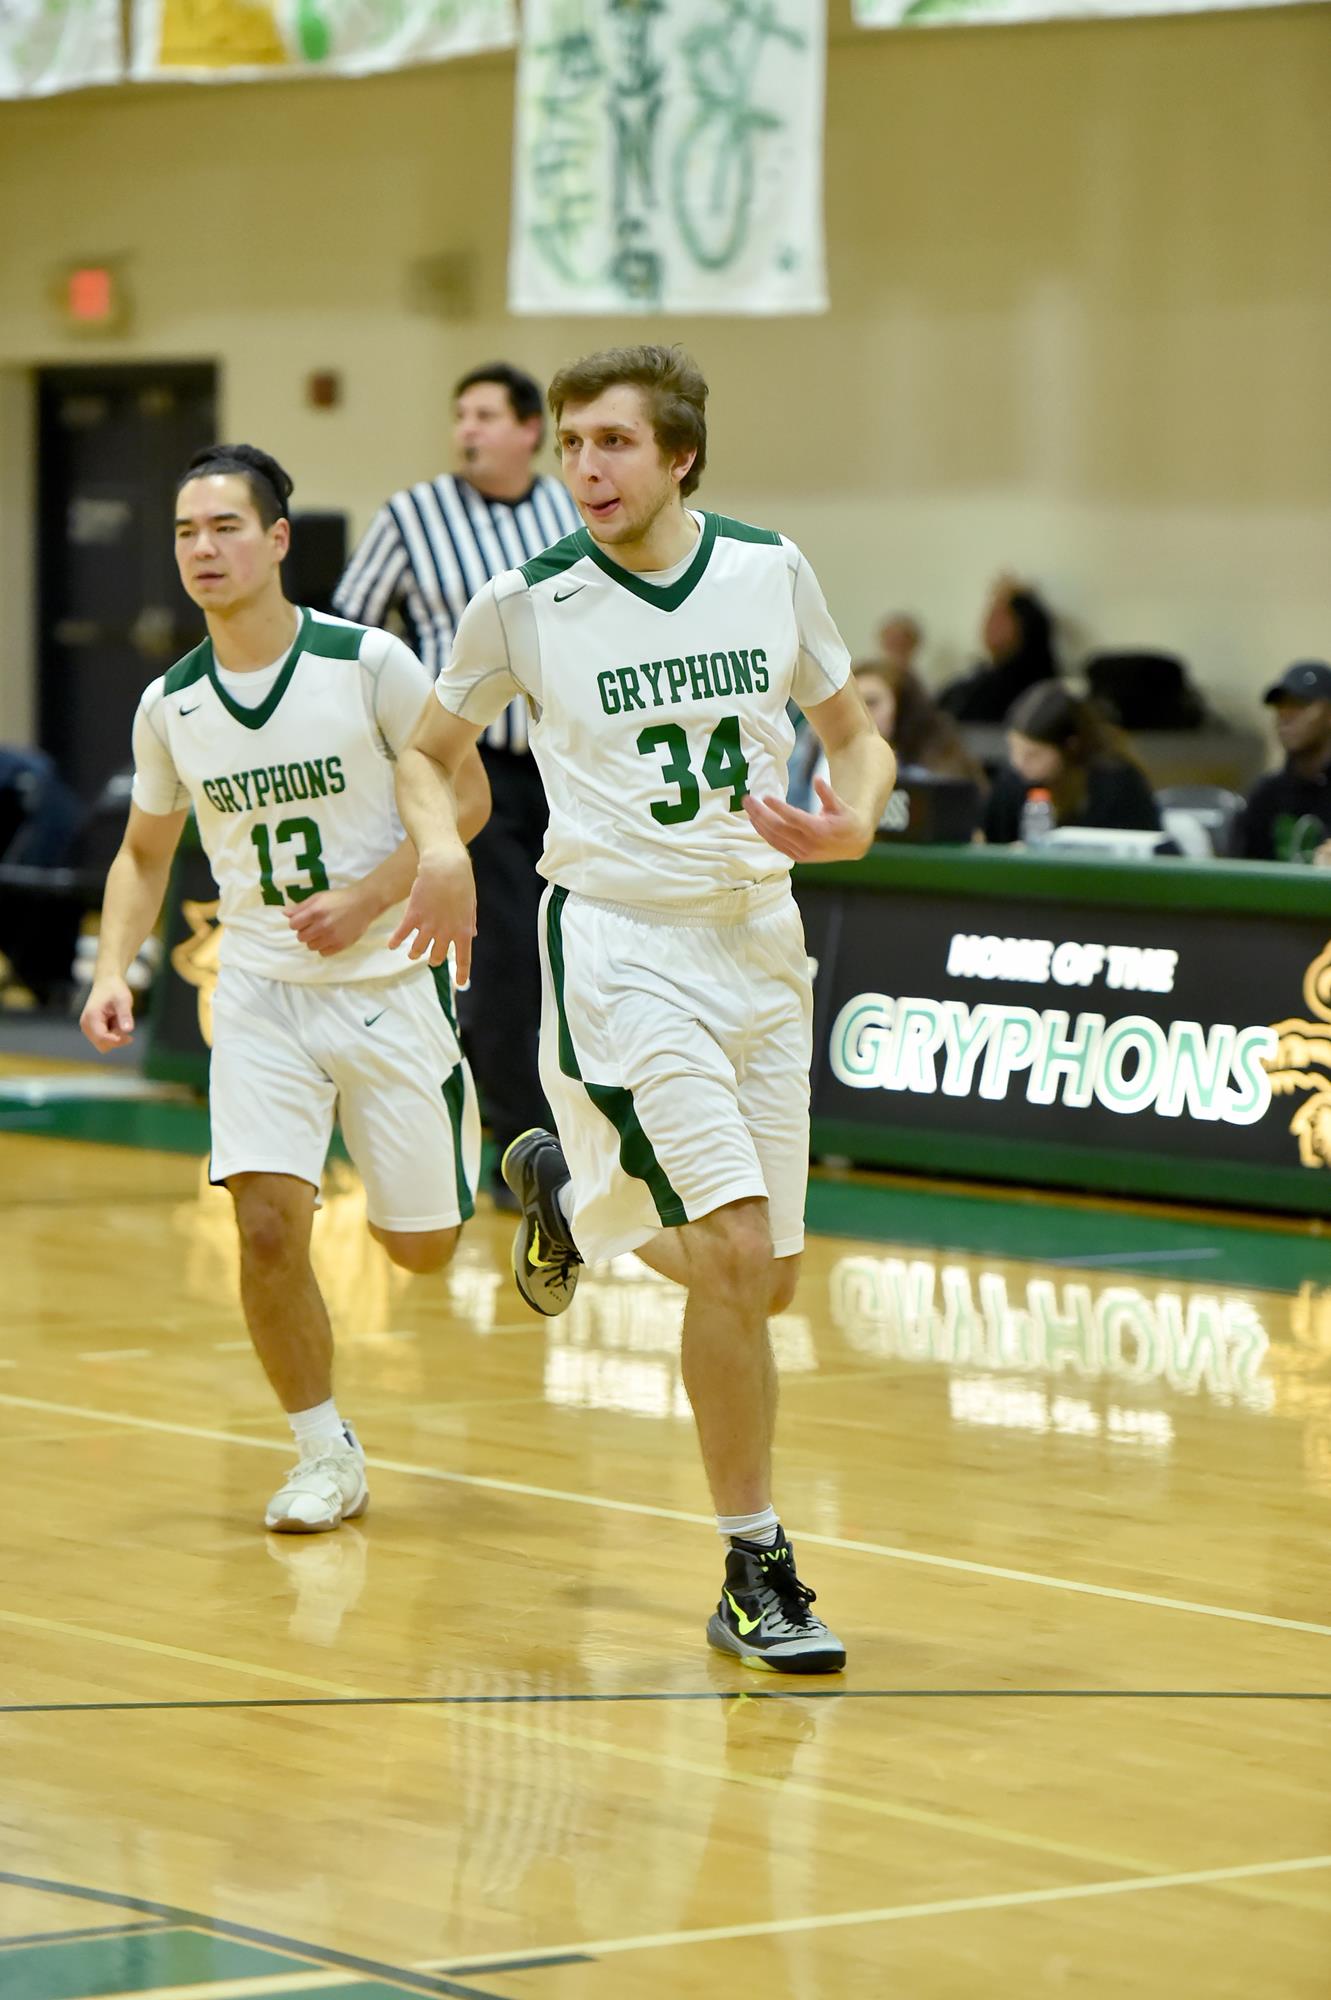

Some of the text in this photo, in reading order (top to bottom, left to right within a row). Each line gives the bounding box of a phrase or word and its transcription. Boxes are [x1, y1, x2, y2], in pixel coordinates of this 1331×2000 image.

[597, 649, 769, 715] GRYPHONS
[202, 755, 346, 813] GRYPHONS
[636, 715, 750, 825] 34
[251, 816, 330, 907] 13
[947, 934, 1178, 993] HOME OF THE
[830, 993, 1279, 1125] GRYPHONS
